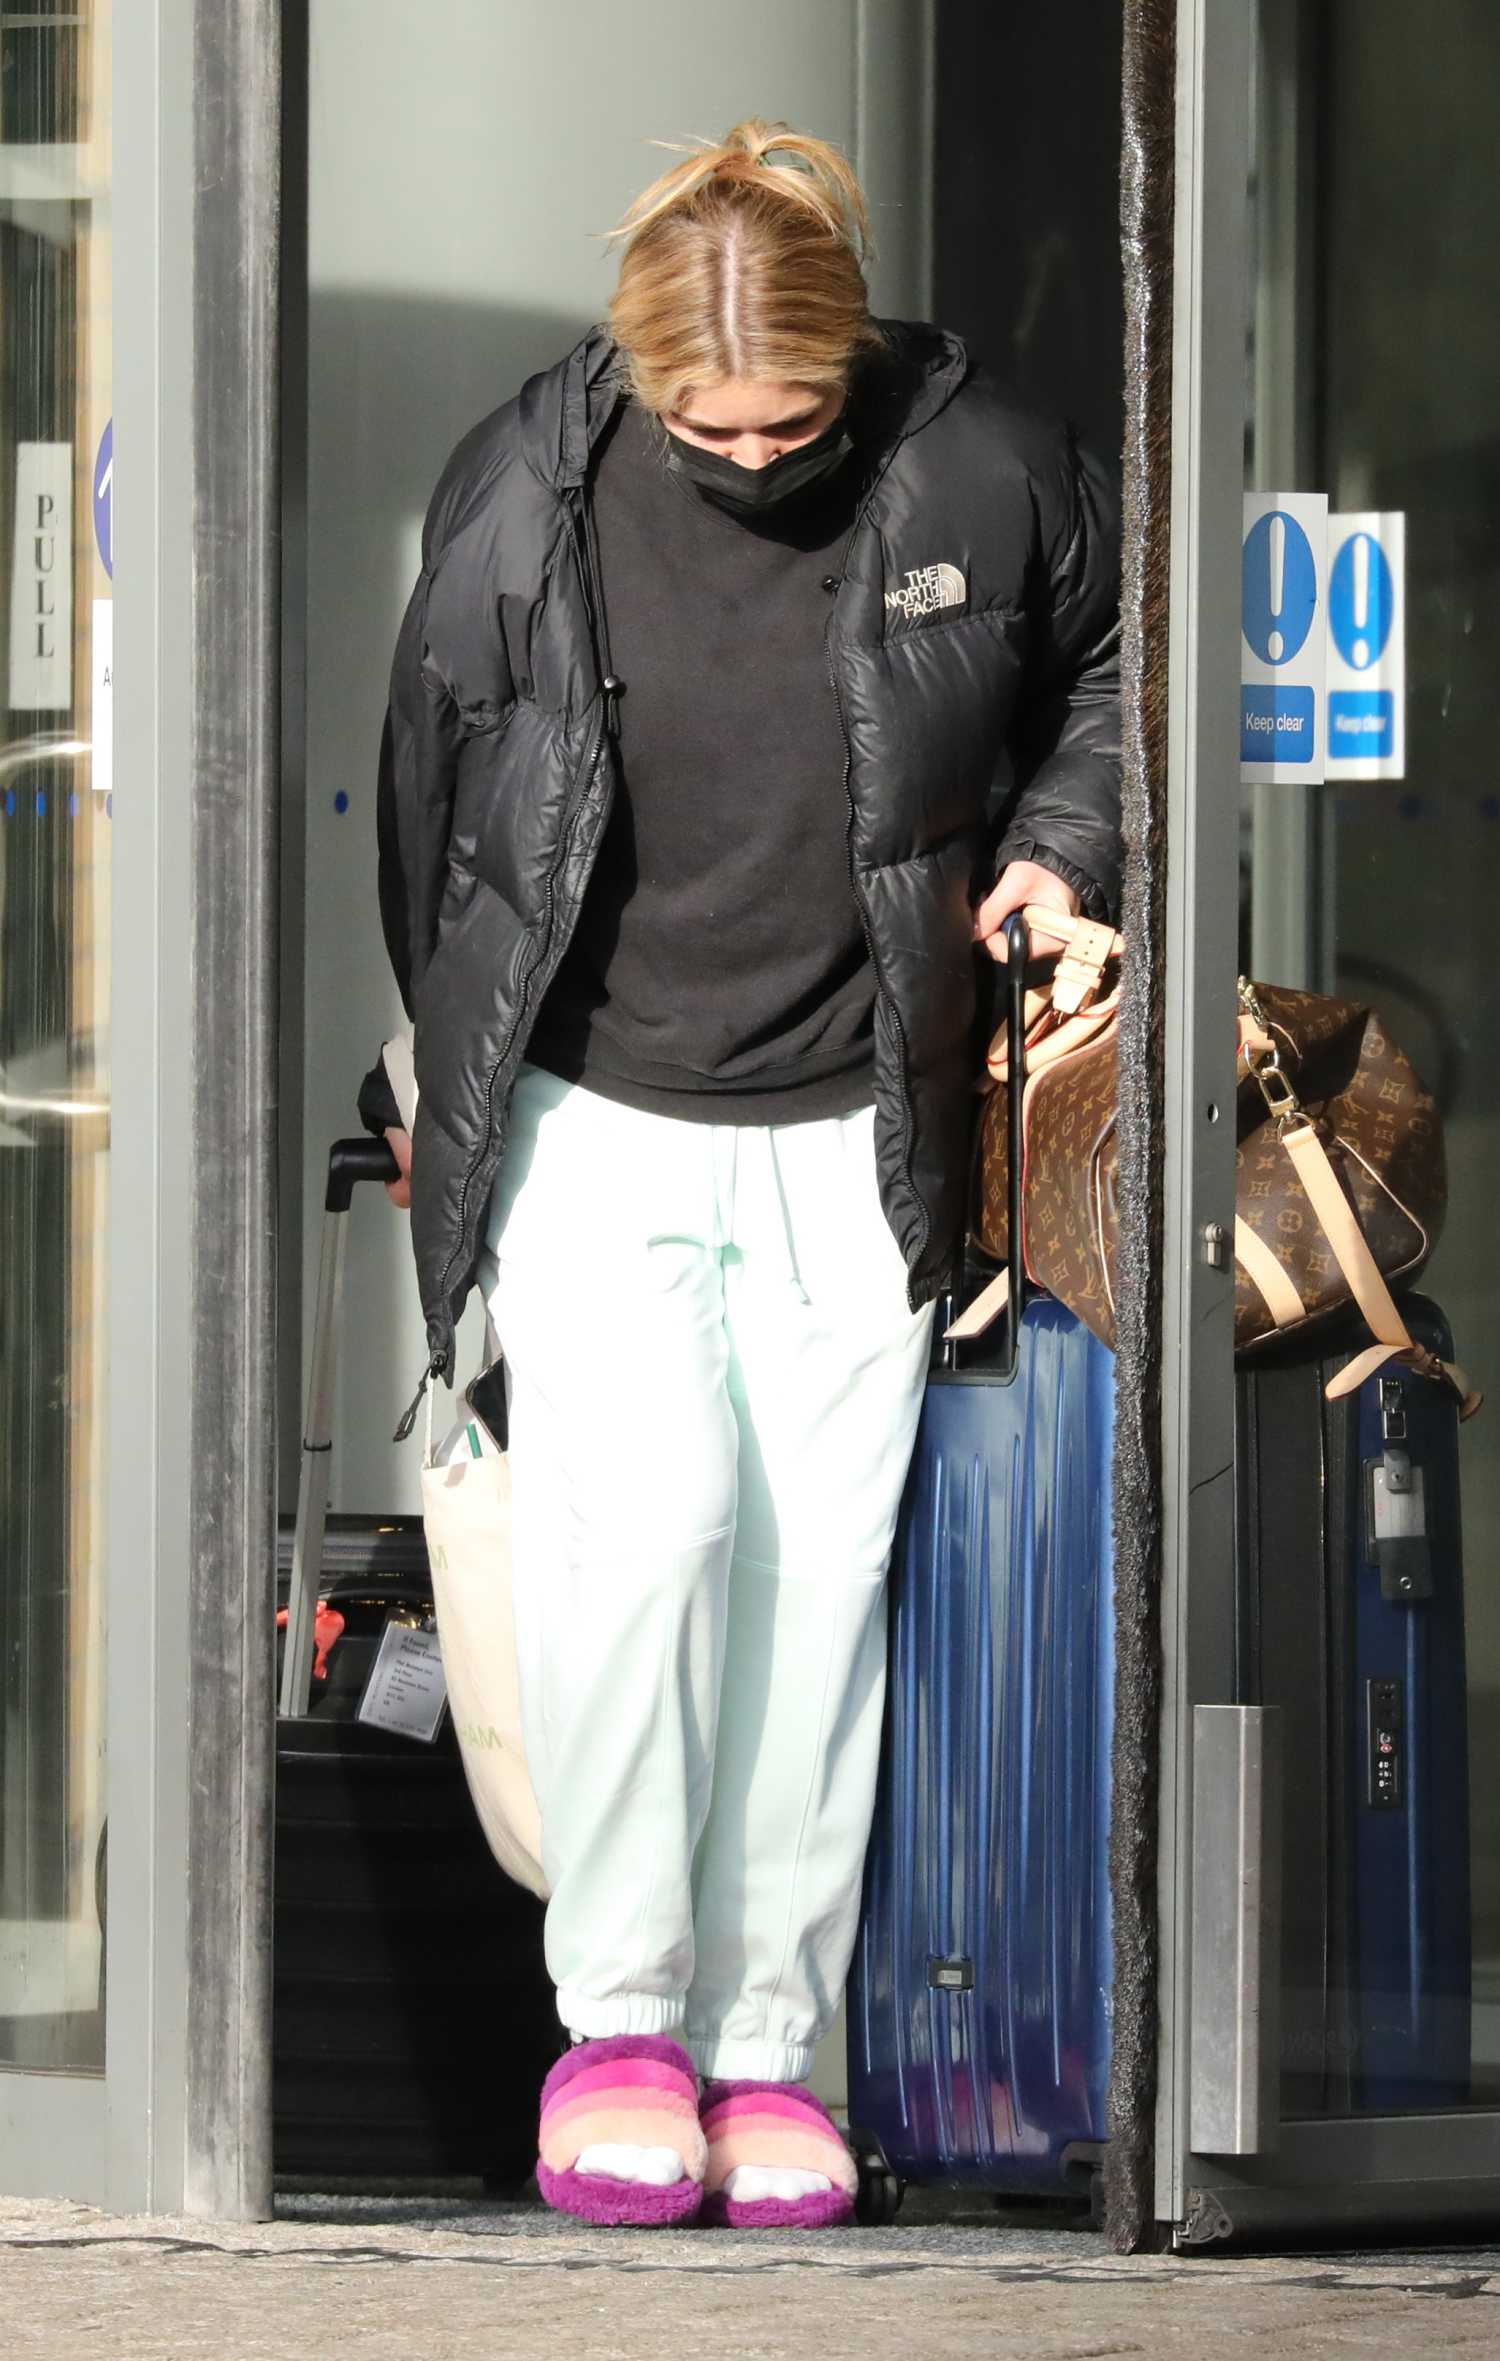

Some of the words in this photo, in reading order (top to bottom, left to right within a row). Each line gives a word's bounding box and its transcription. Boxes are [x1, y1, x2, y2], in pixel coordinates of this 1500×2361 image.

[34, 494, 54, 658] PULL
[904, 565, 939, 587] THE
[884, 580, 942, 609] NORTH
[903, 597, 942, 619] FACE
[1245, 712, 1274, 734] Keep
[1276, 713, 1304, 731] clear
